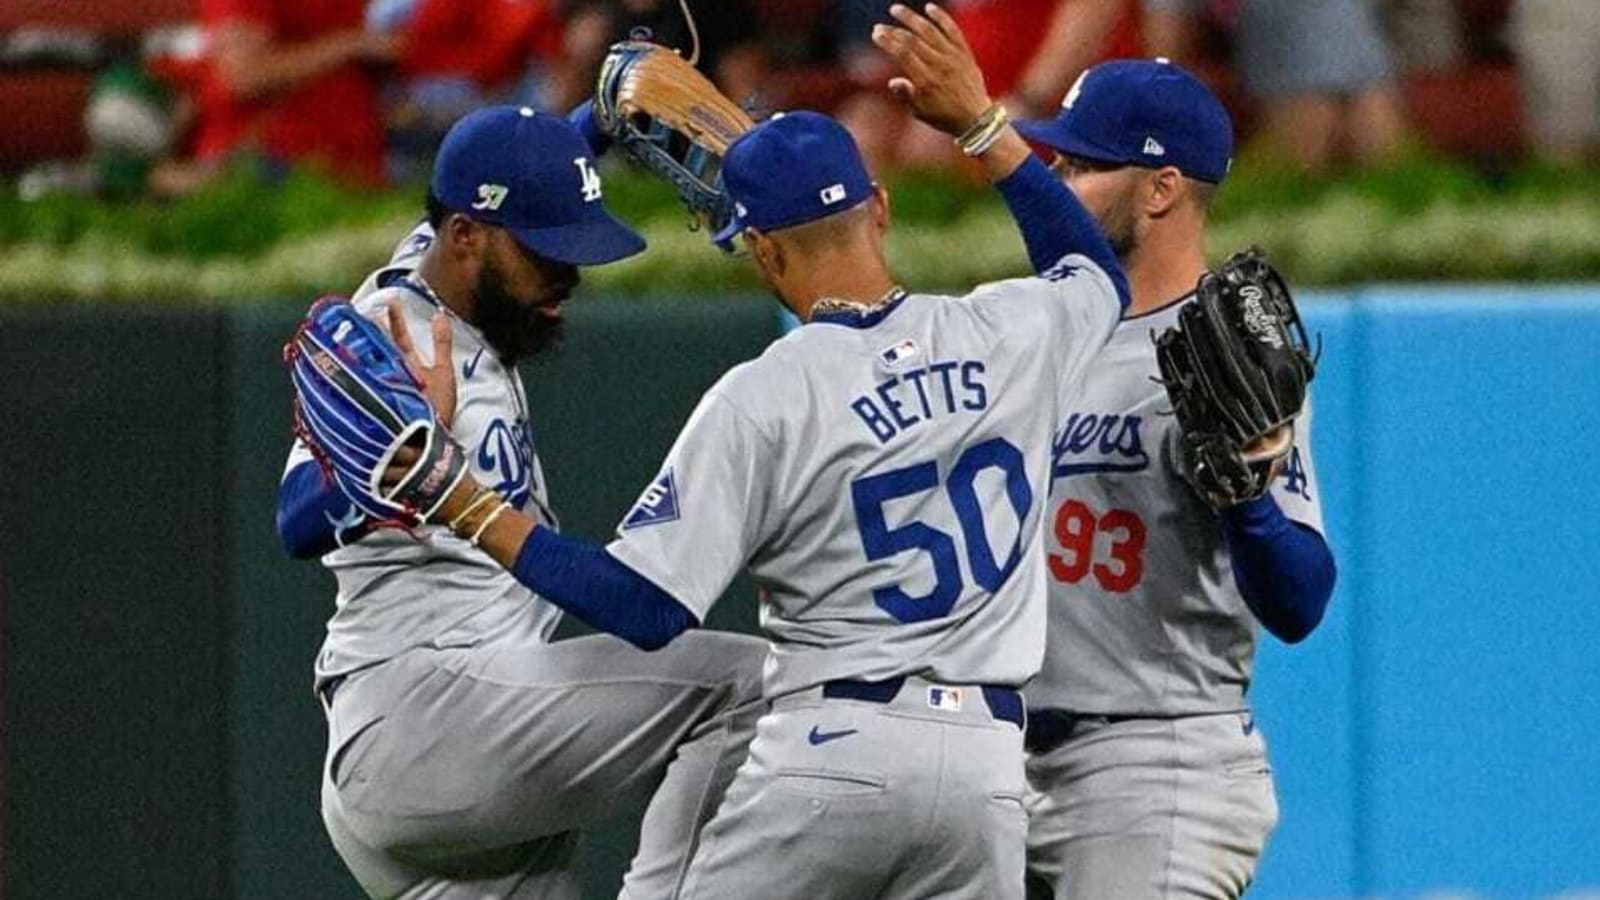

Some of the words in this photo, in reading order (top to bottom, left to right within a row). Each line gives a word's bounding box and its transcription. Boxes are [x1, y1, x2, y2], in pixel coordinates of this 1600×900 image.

[573, 156, 603, 203] LA
[850, 359, 988, 445] BETTS
[851, 436, 1033, 626] 50
[1046, 498, 1147, 595] 93
